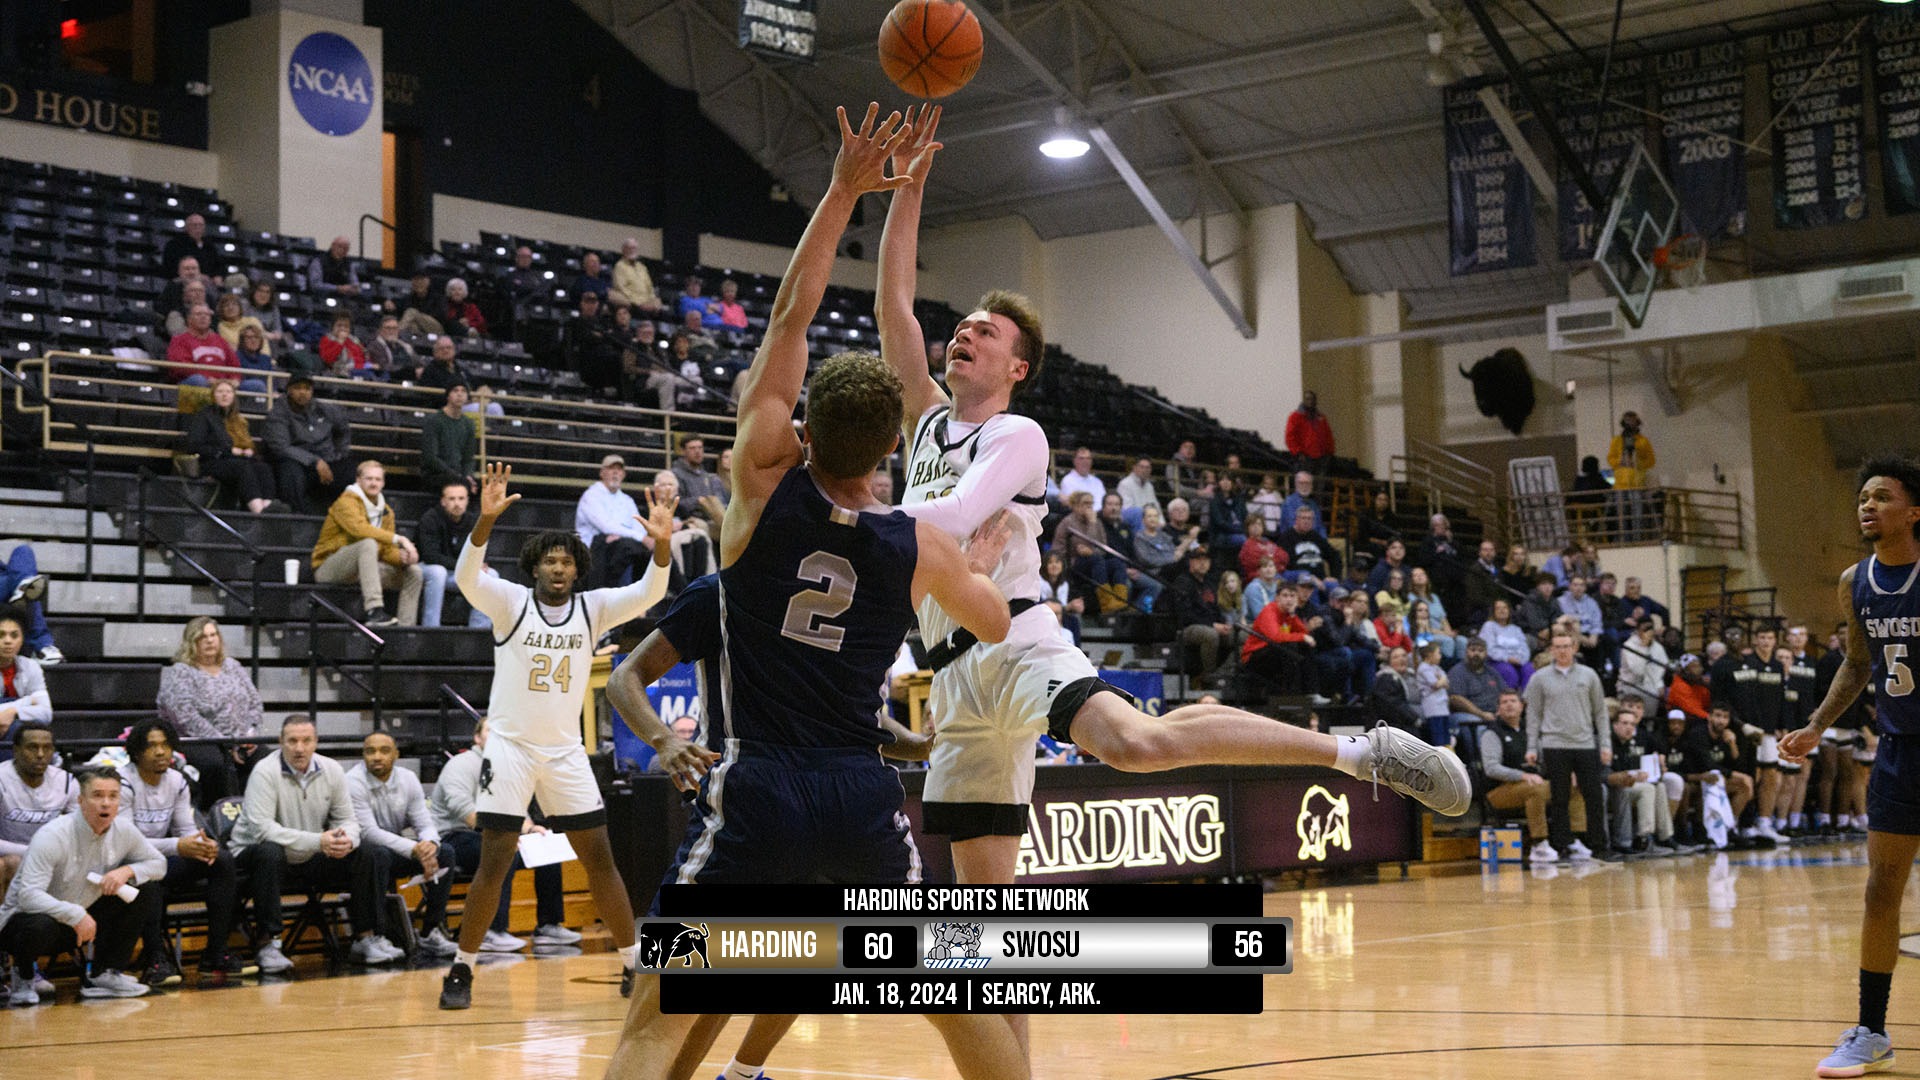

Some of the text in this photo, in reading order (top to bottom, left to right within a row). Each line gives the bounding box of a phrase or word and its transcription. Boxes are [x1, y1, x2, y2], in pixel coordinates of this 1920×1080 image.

[293, 63, 369, 103] NCAA
[1661, 88, 1694, 106] GULF
[1697, 81, 1742, 99] SOUTH
[1772, 69, 1808, 87] GULF
[35, 88, 161, 140] HOUSE
[1679, 135, 1731, 163] 2003
[781, 550, 858, 652] 2
[523, 631, 583, 650] HARDING
[528, 653, 572, 693] 24
[1883, 643, 1916, 698] 5
